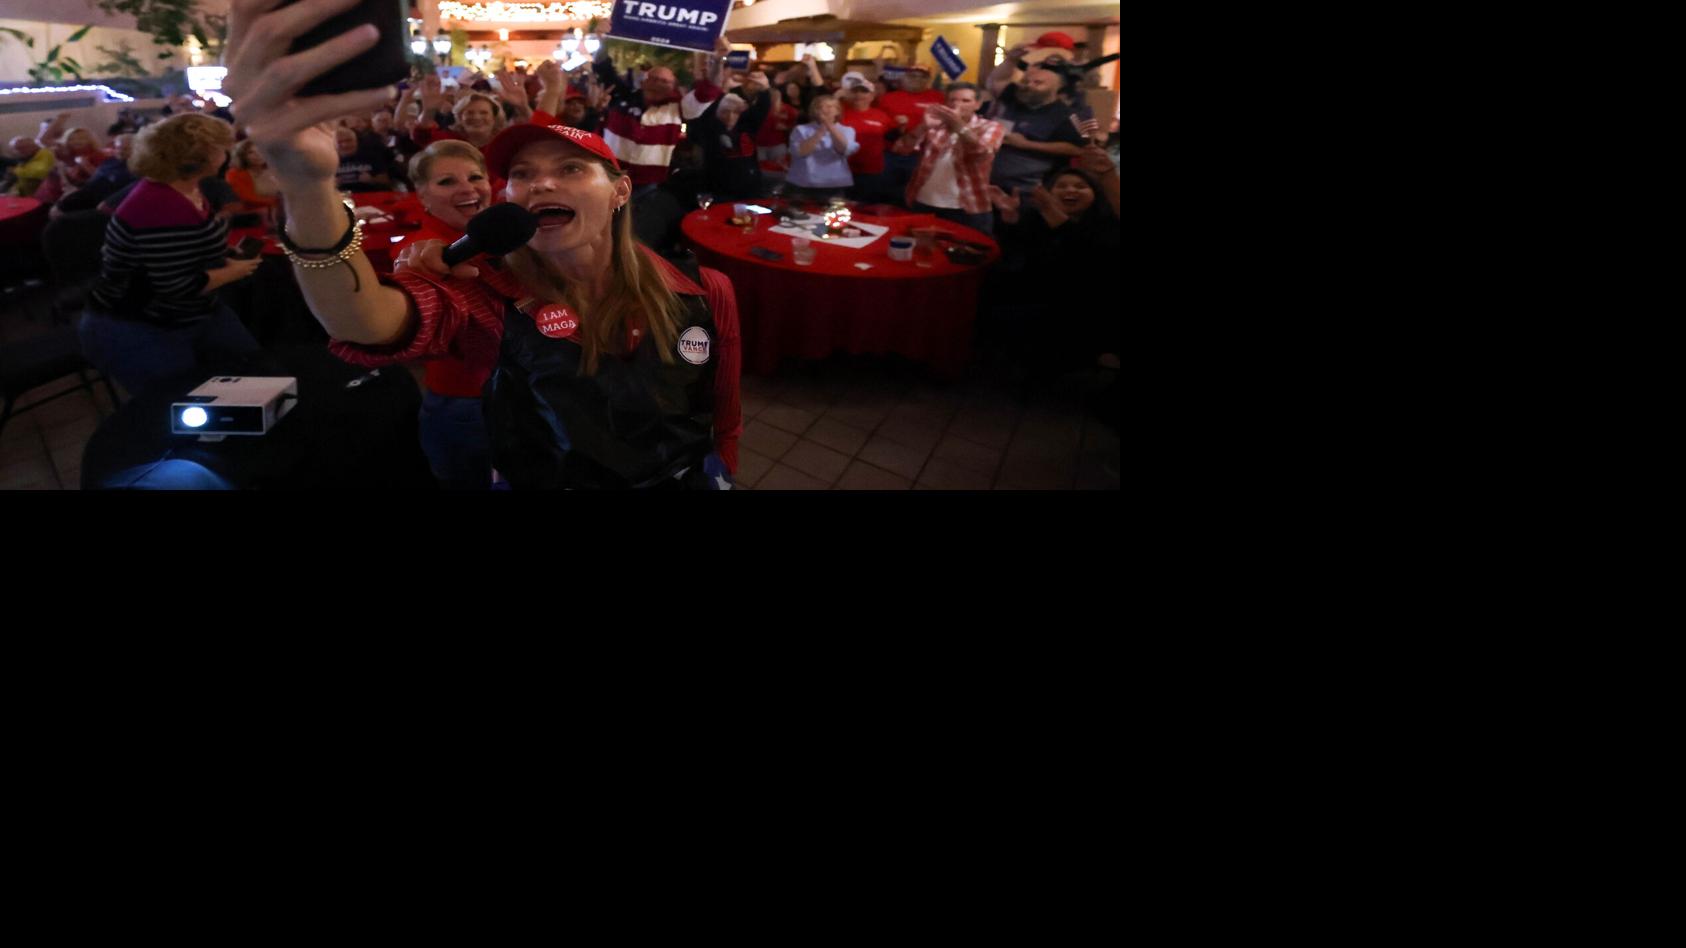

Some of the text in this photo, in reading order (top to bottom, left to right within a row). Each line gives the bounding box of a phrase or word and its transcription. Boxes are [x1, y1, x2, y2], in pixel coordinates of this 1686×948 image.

[623, 1, 718, 26] TRUMP
[543, 308, 568, 321] I AM
[542, 319, 577, 333] MAGA
